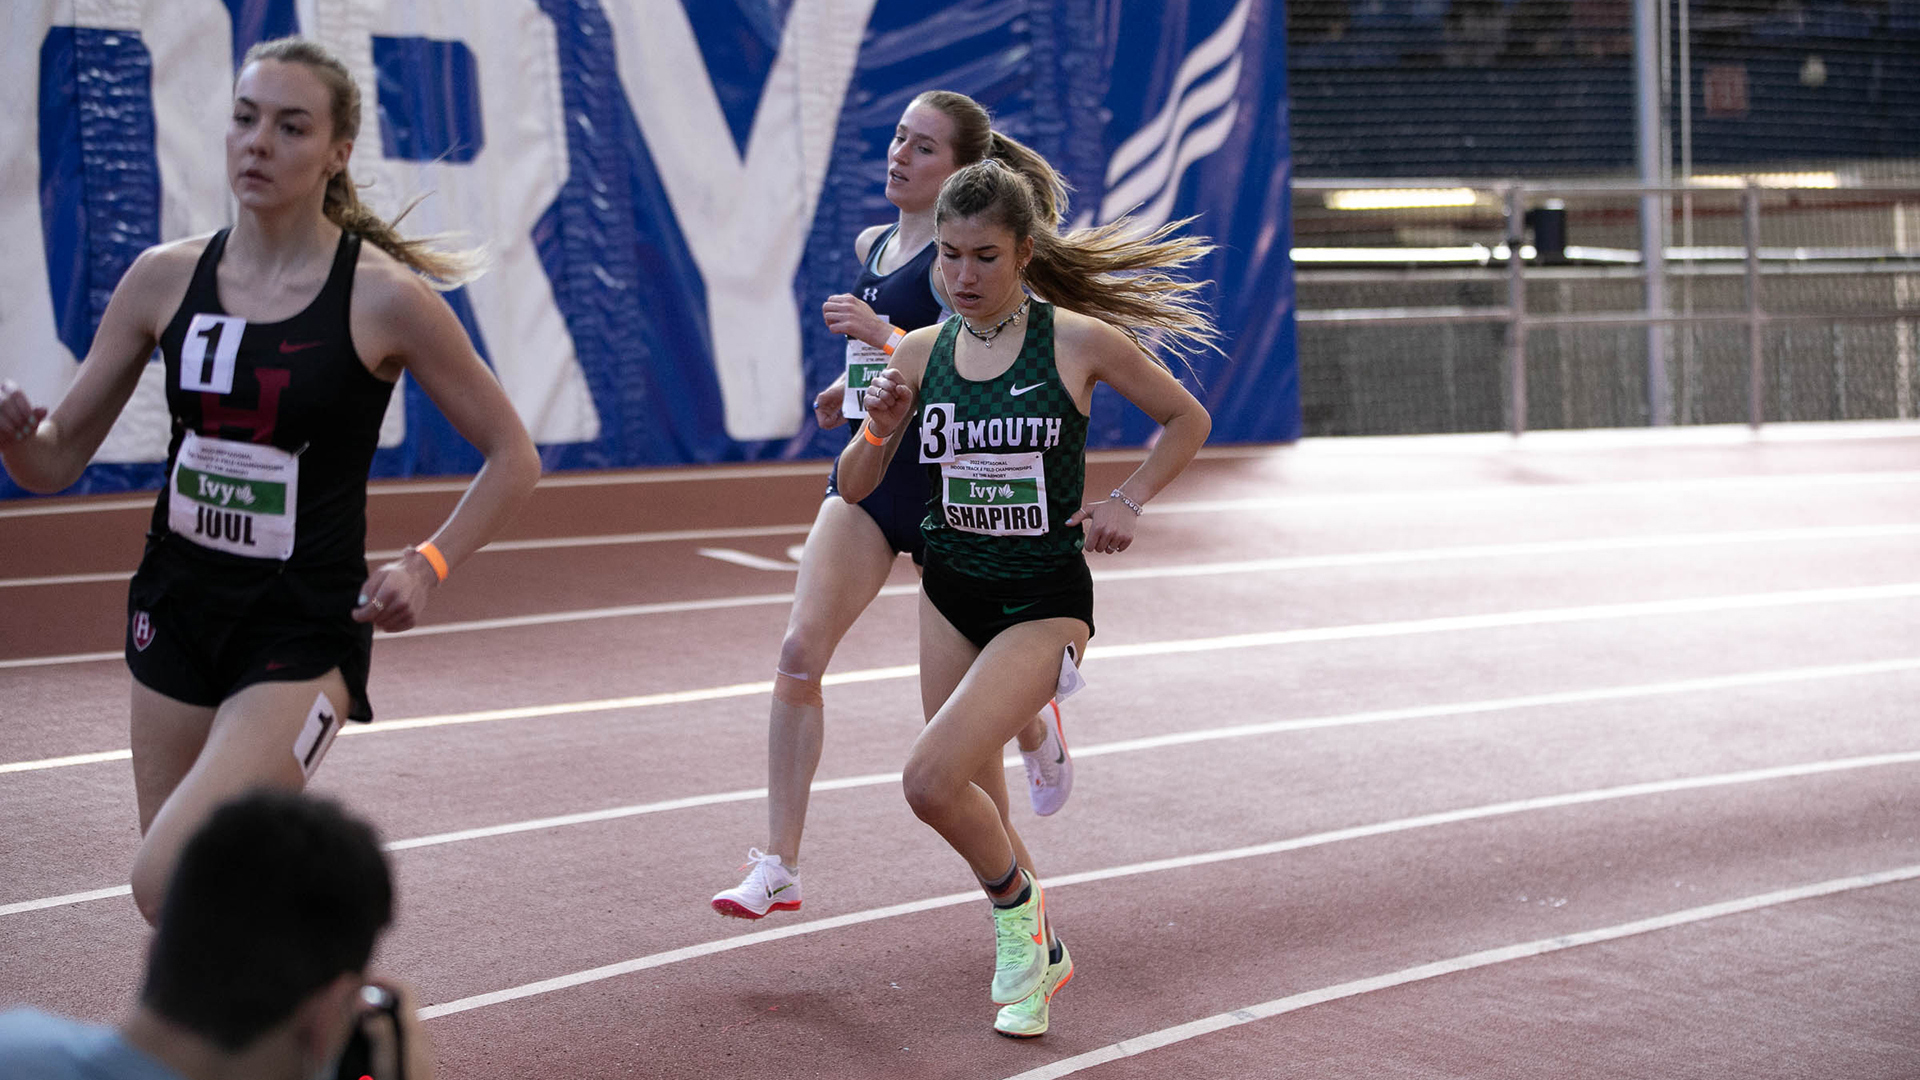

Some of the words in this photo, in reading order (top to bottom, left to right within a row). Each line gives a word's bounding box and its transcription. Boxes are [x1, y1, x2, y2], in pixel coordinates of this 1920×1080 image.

[197, 322, 225, 385] 1
[923, 407, 947, 459] 3
[952, 417, 1062, 450] TMOUTH
[199, 474, 235, 506] Ivy
[969, 482, 997, 503] Ivy
[195, 505, 256, 546] JUUL
[946, 505, 1043, 530] SHAPIRO
[304, 712, 334, 769] 1
